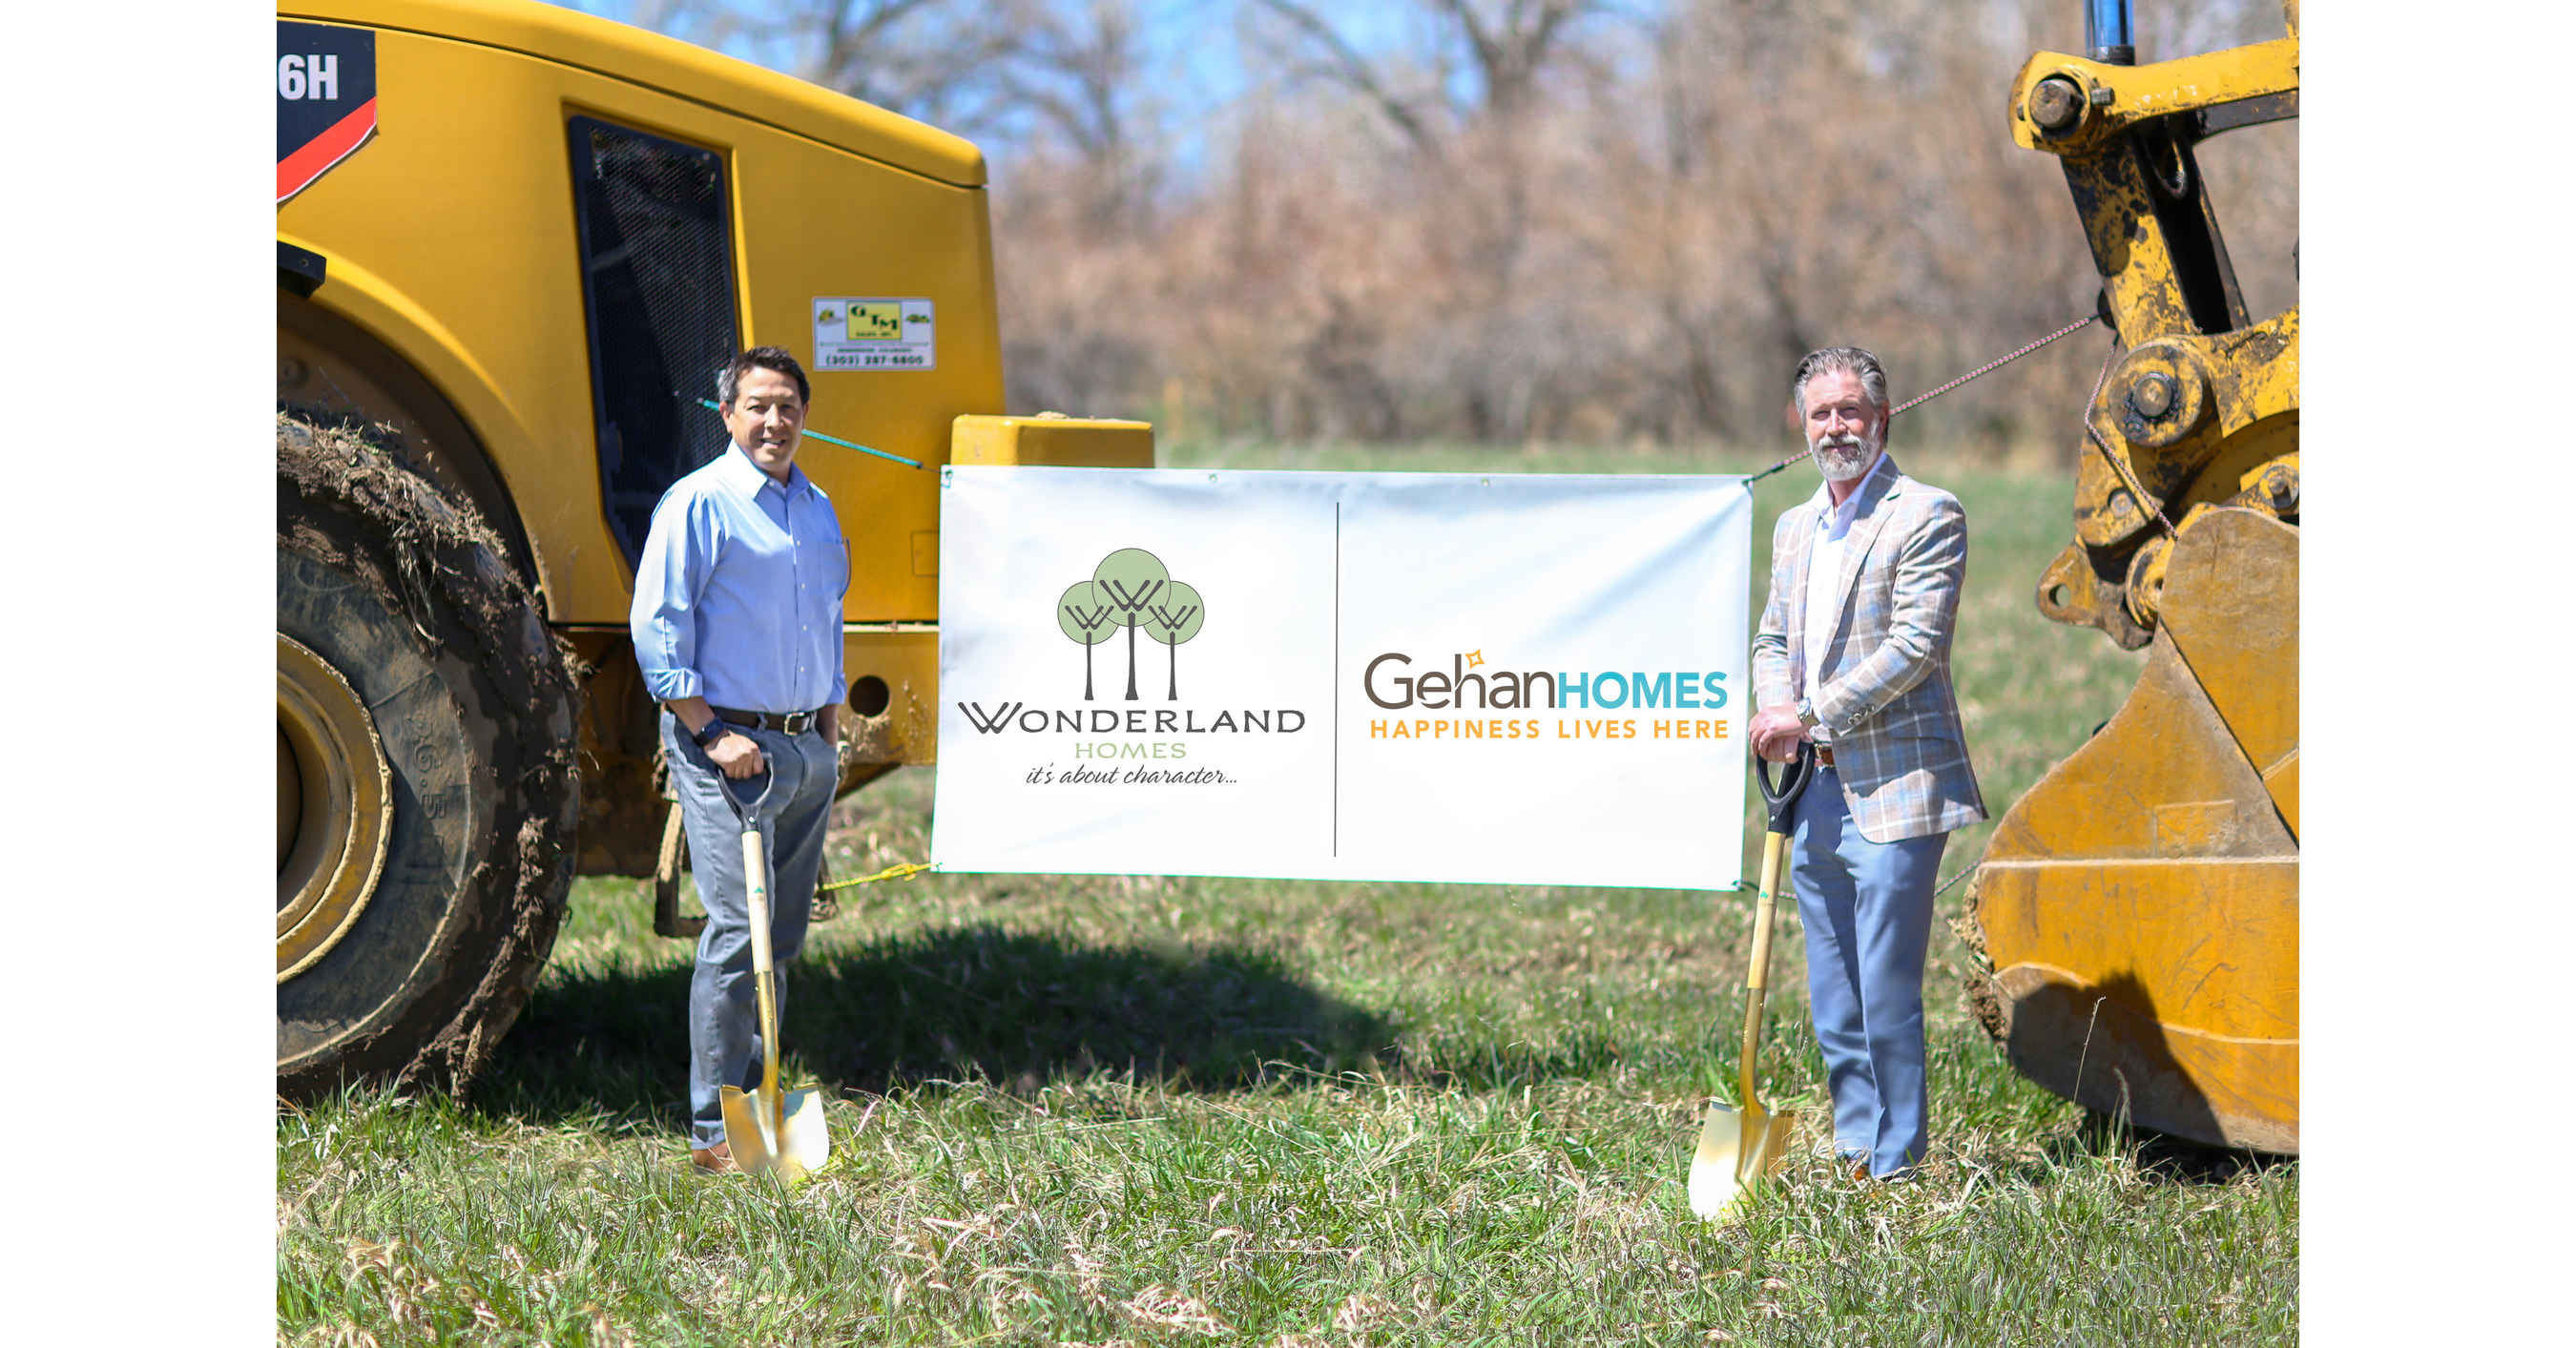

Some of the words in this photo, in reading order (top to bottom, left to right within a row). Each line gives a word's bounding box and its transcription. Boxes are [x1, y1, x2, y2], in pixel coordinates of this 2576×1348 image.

[278, 53, 339, 100] 6H
[958, 701, 1305, 734] WONDERLAND
[1371, 719, 1540, 739] HAPPINESS
[1559, 719, 1636, 739] LIVES
[1654, 719, 1729, 739] HERE
[1075, 742, 1187, 759] HOMES
[1026, 762, 1054, 784] it's
[1060, 763, 1120, 784] about
